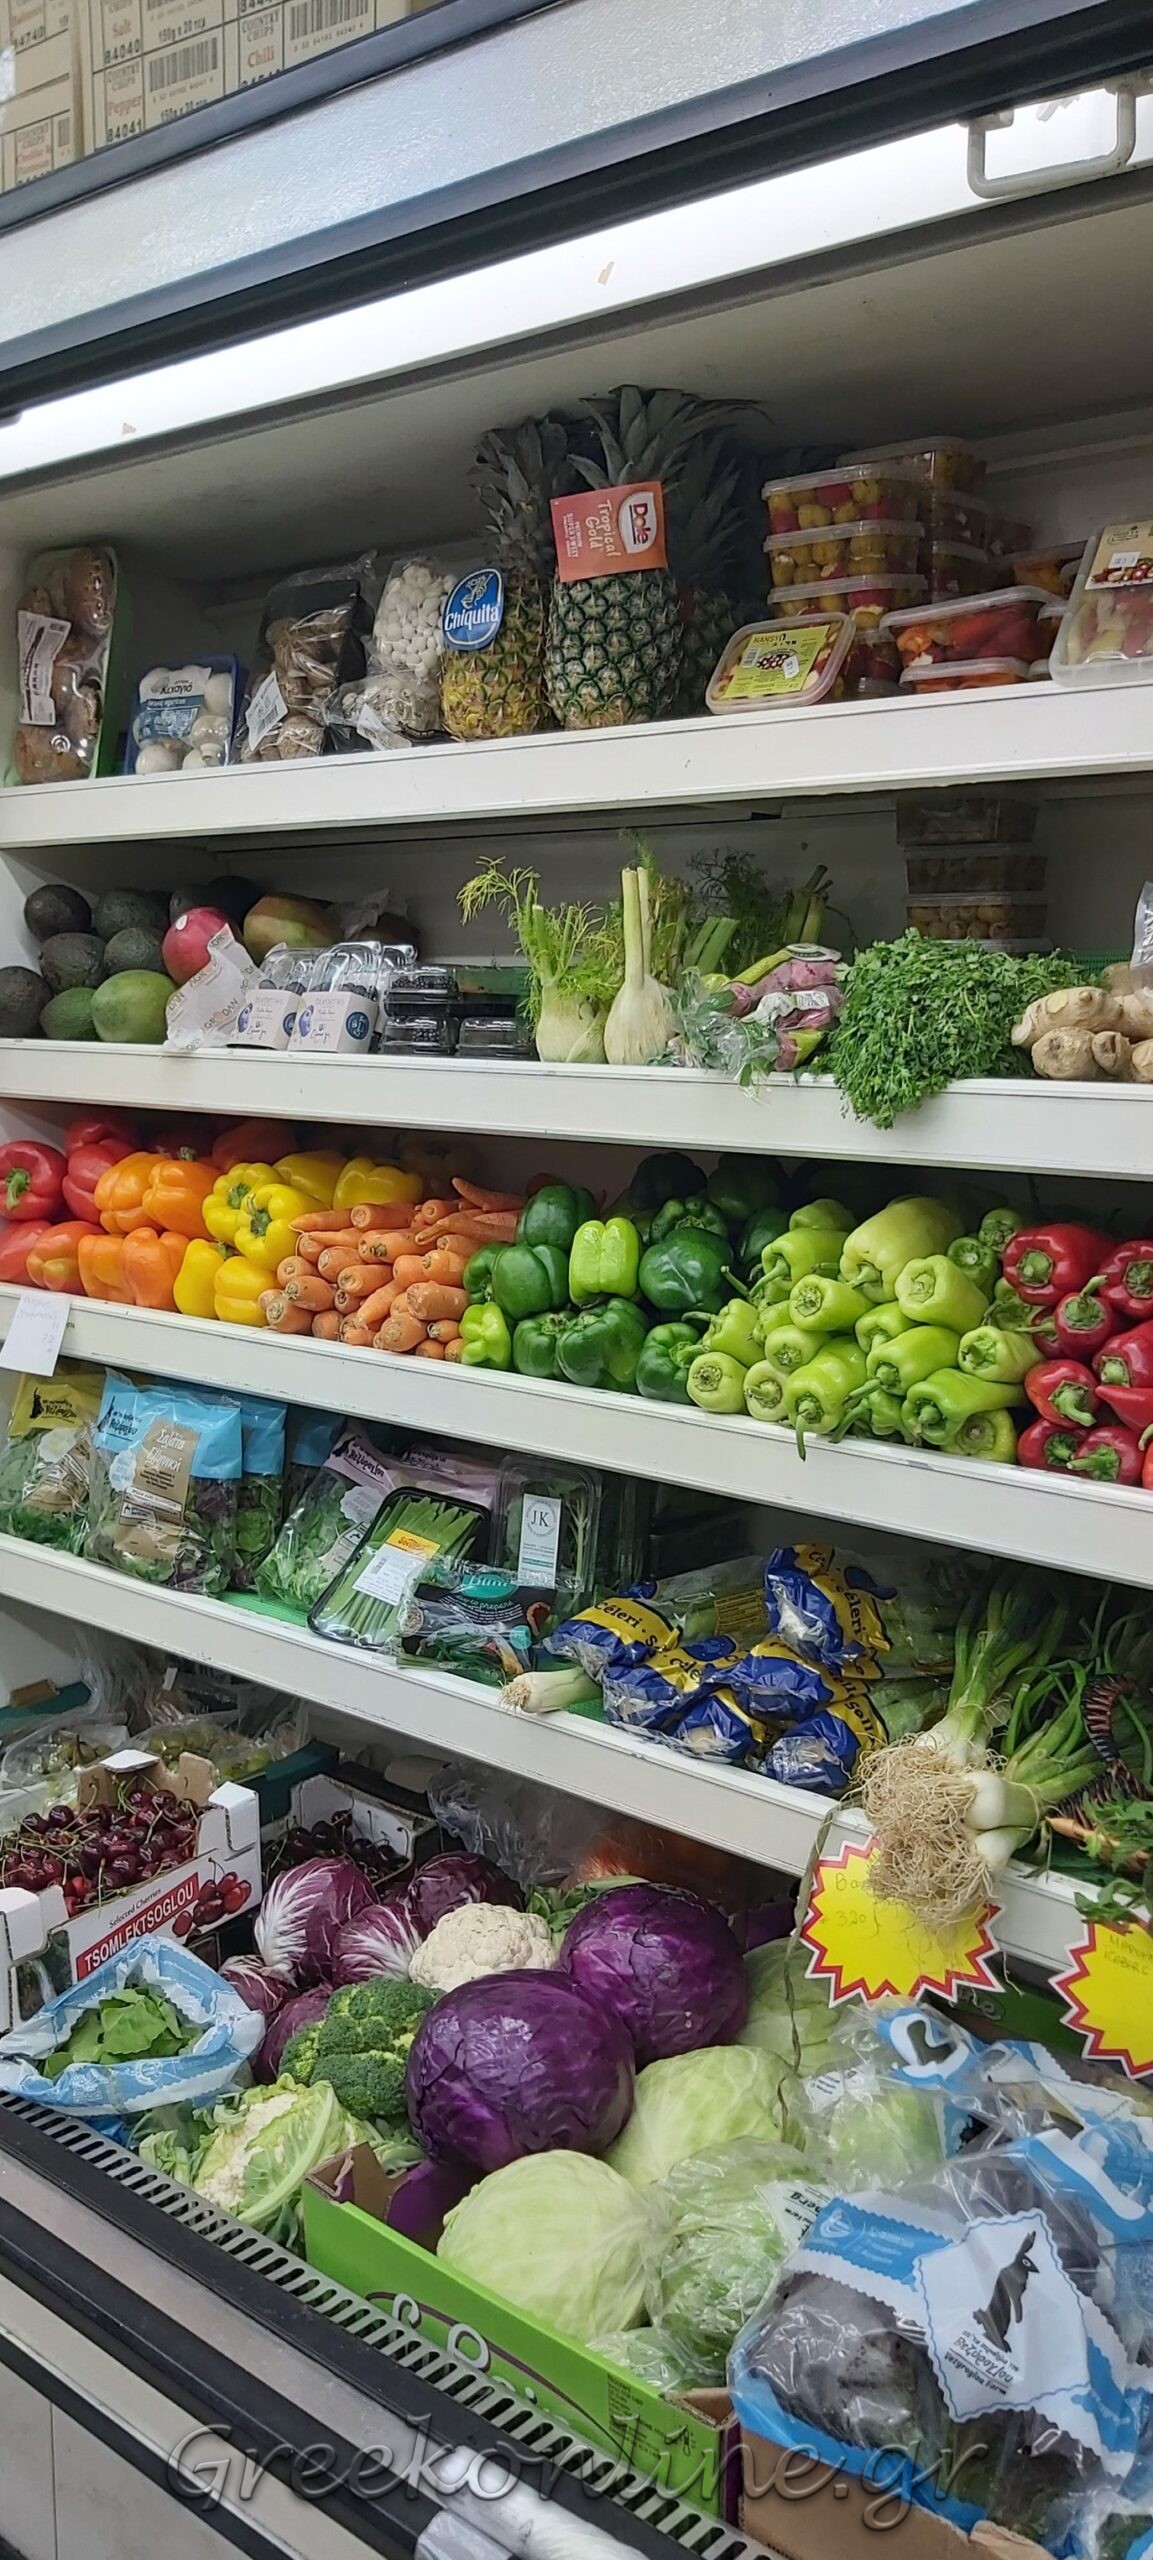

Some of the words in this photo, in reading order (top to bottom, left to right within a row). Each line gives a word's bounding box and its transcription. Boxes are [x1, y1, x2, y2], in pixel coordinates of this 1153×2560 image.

[247, 46, 275, 68] Chili
[584, 515, 603, 550] Gold
[597, 500, 621, 557] Tropical
[630, 501, 649, 546] Dole
[444, 606, 499, 632] Chiquita
[83, 1881, 195, 1971] TSOMLEKTSOGLOU
[108, 1904, 137, 1928] Selected
